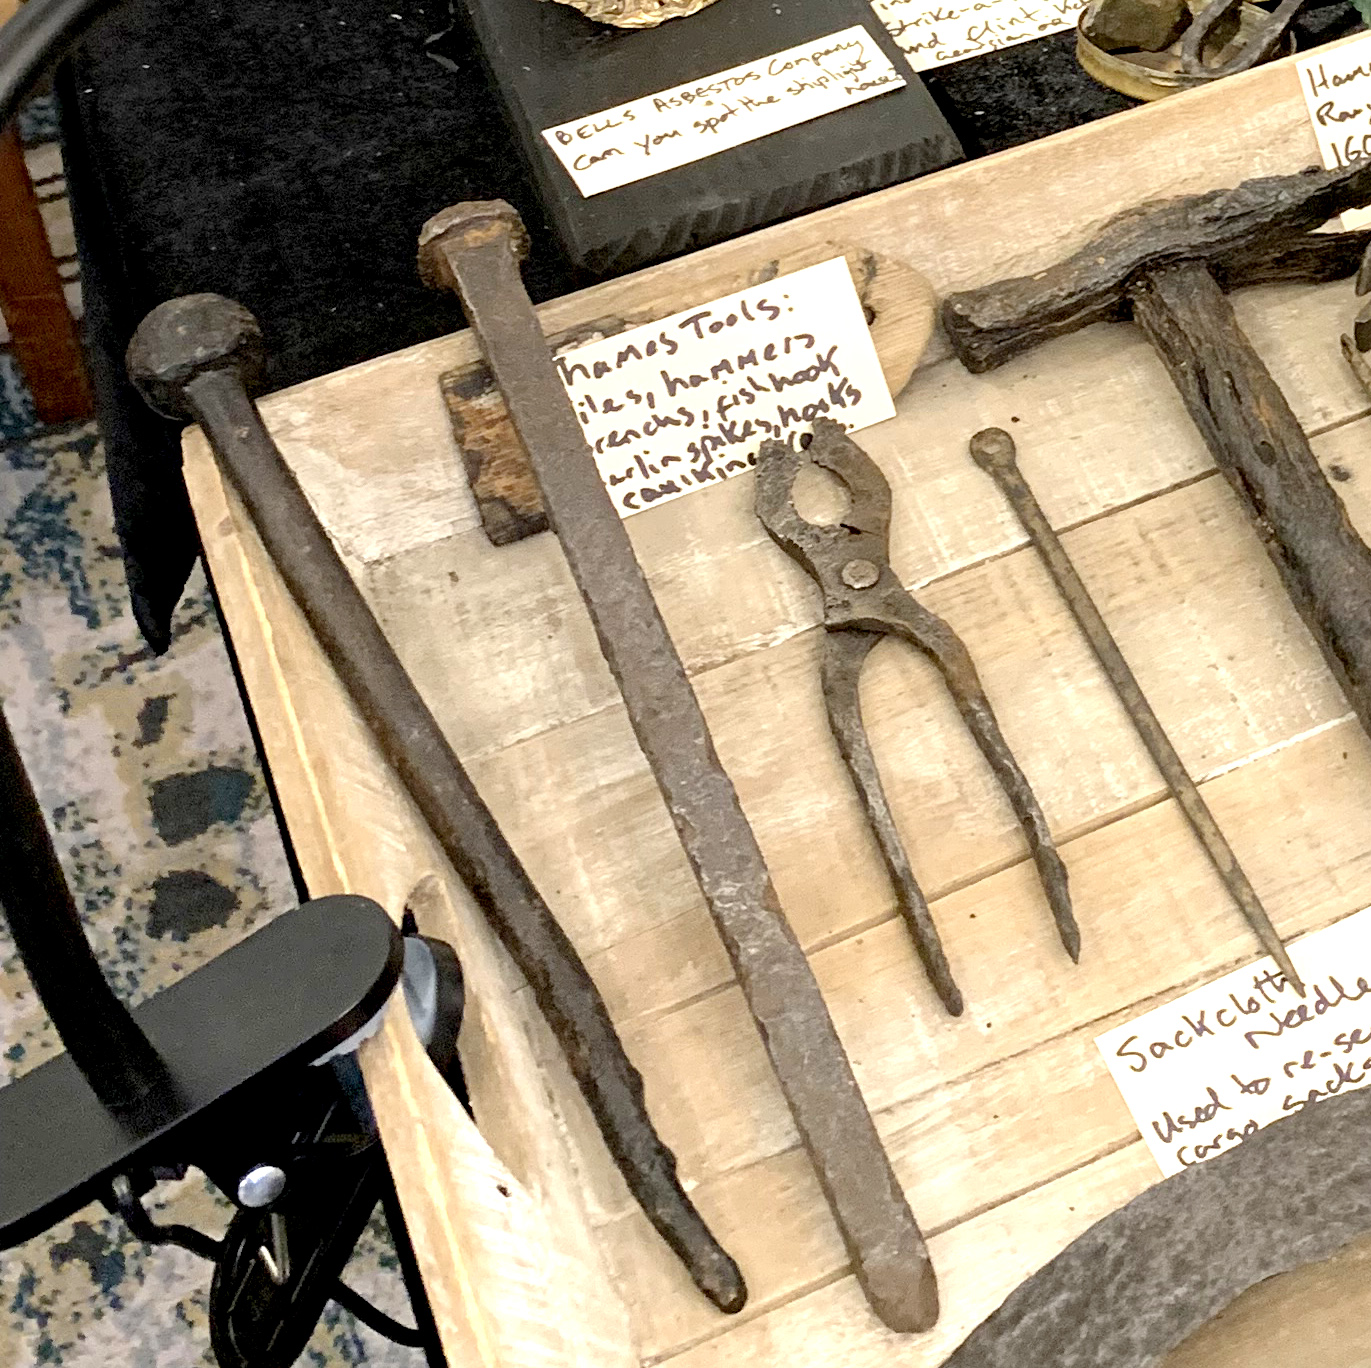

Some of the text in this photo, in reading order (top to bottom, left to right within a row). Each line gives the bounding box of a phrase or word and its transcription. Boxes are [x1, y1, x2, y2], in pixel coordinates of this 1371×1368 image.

[555, 109, 637, 146] BELLS
[652, 71, 762, 113] ASBESTOS
[692, 102, 739, 134] spot
[737, 95, 782, 112] the
[679, 293, 795, 340] Tools:
[578, 333, 816, 425] iles, hammers
[1151, 1086, 1233, 1144] Used
[1229, 1073, 1272, 1097] to
